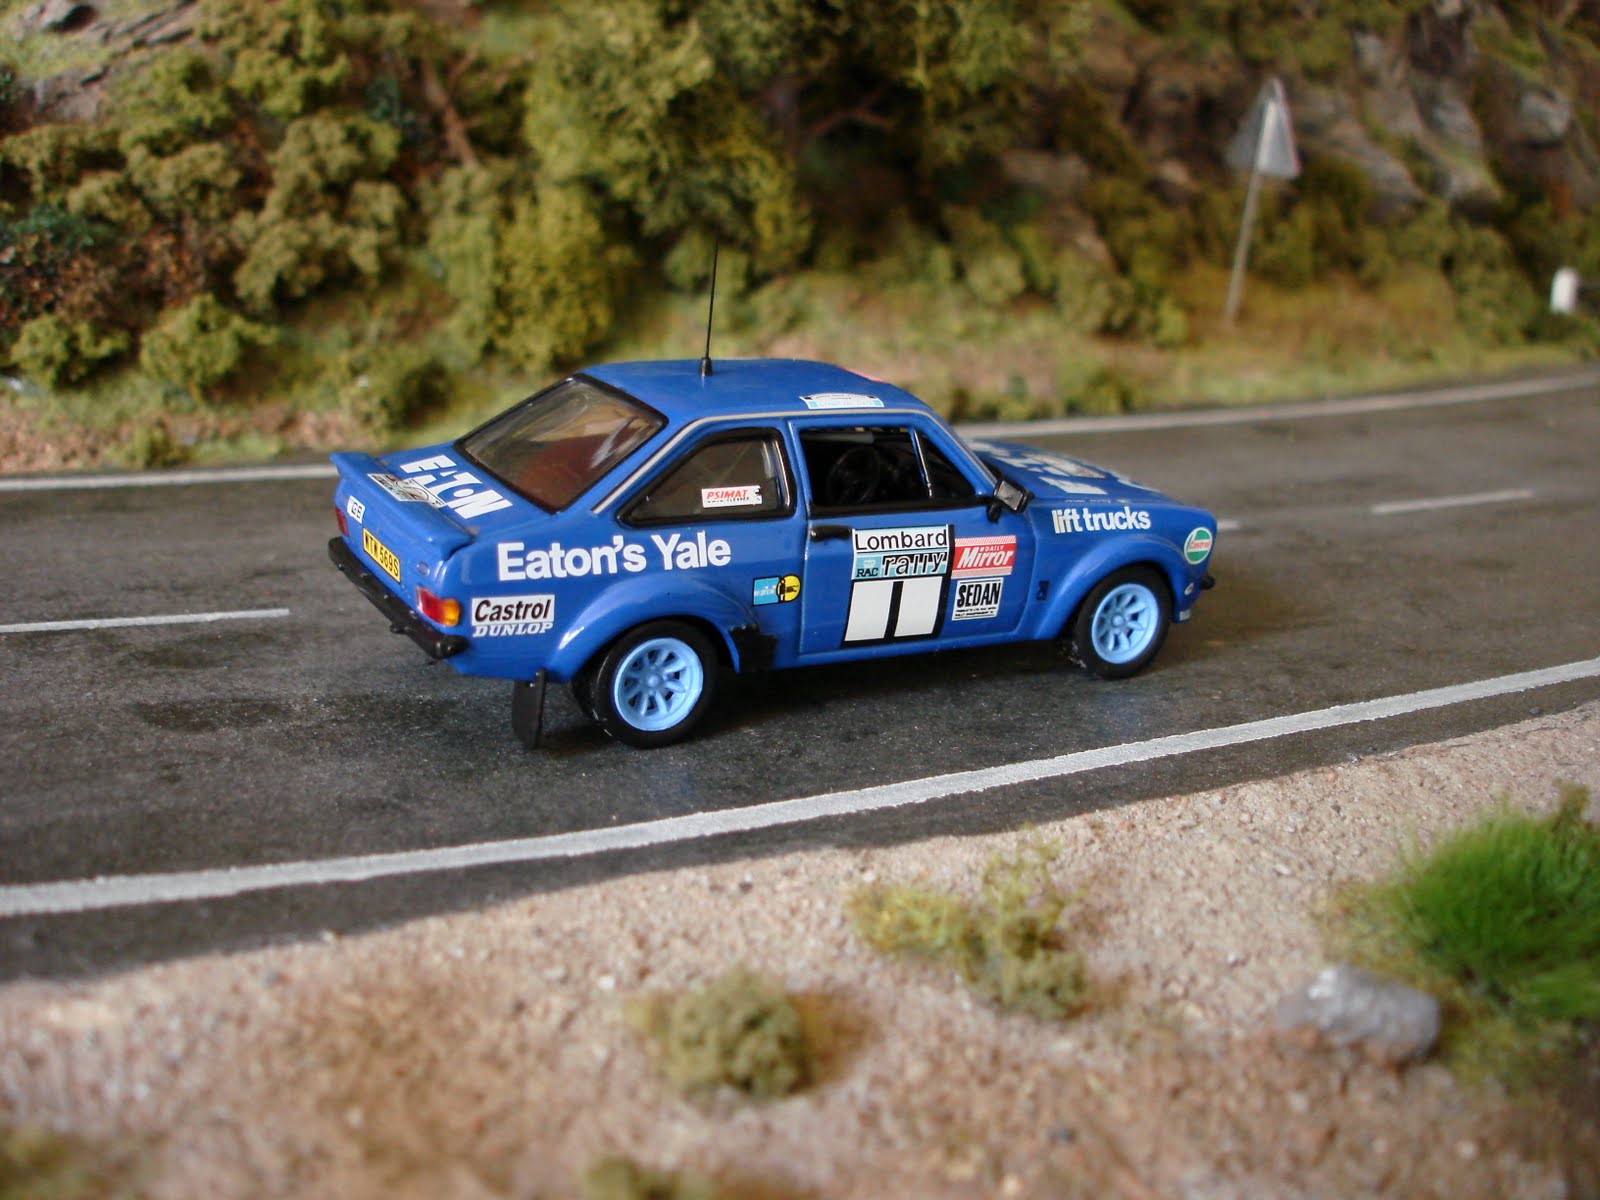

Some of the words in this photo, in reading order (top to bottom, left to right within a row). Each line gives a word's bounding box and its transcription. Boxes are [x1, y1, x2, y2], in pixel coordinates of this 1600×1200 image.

[706, 489, 749, 499] PSIMAT
[350, 501, 363, 519] GB
[1052, 507, 1083, 534] lift
[1082, 506, 1151, 531] trucks
[854, 528, 948, 551] Lombard
[984, 544, 1005, 552] DAILY
[498, 535, 647, 581] Eaton's
[651, 530, 731, 571] Yale
[856, 567, 879, 578] RAC
[882, 553, 947, 577] rally
[957, 546, 1014, 569] Mirror
[956, 582, 1002, 608] SEDAN
[474, 598, 552, 622] Castrol
[472, 621, 554, 638] DUNLOP
